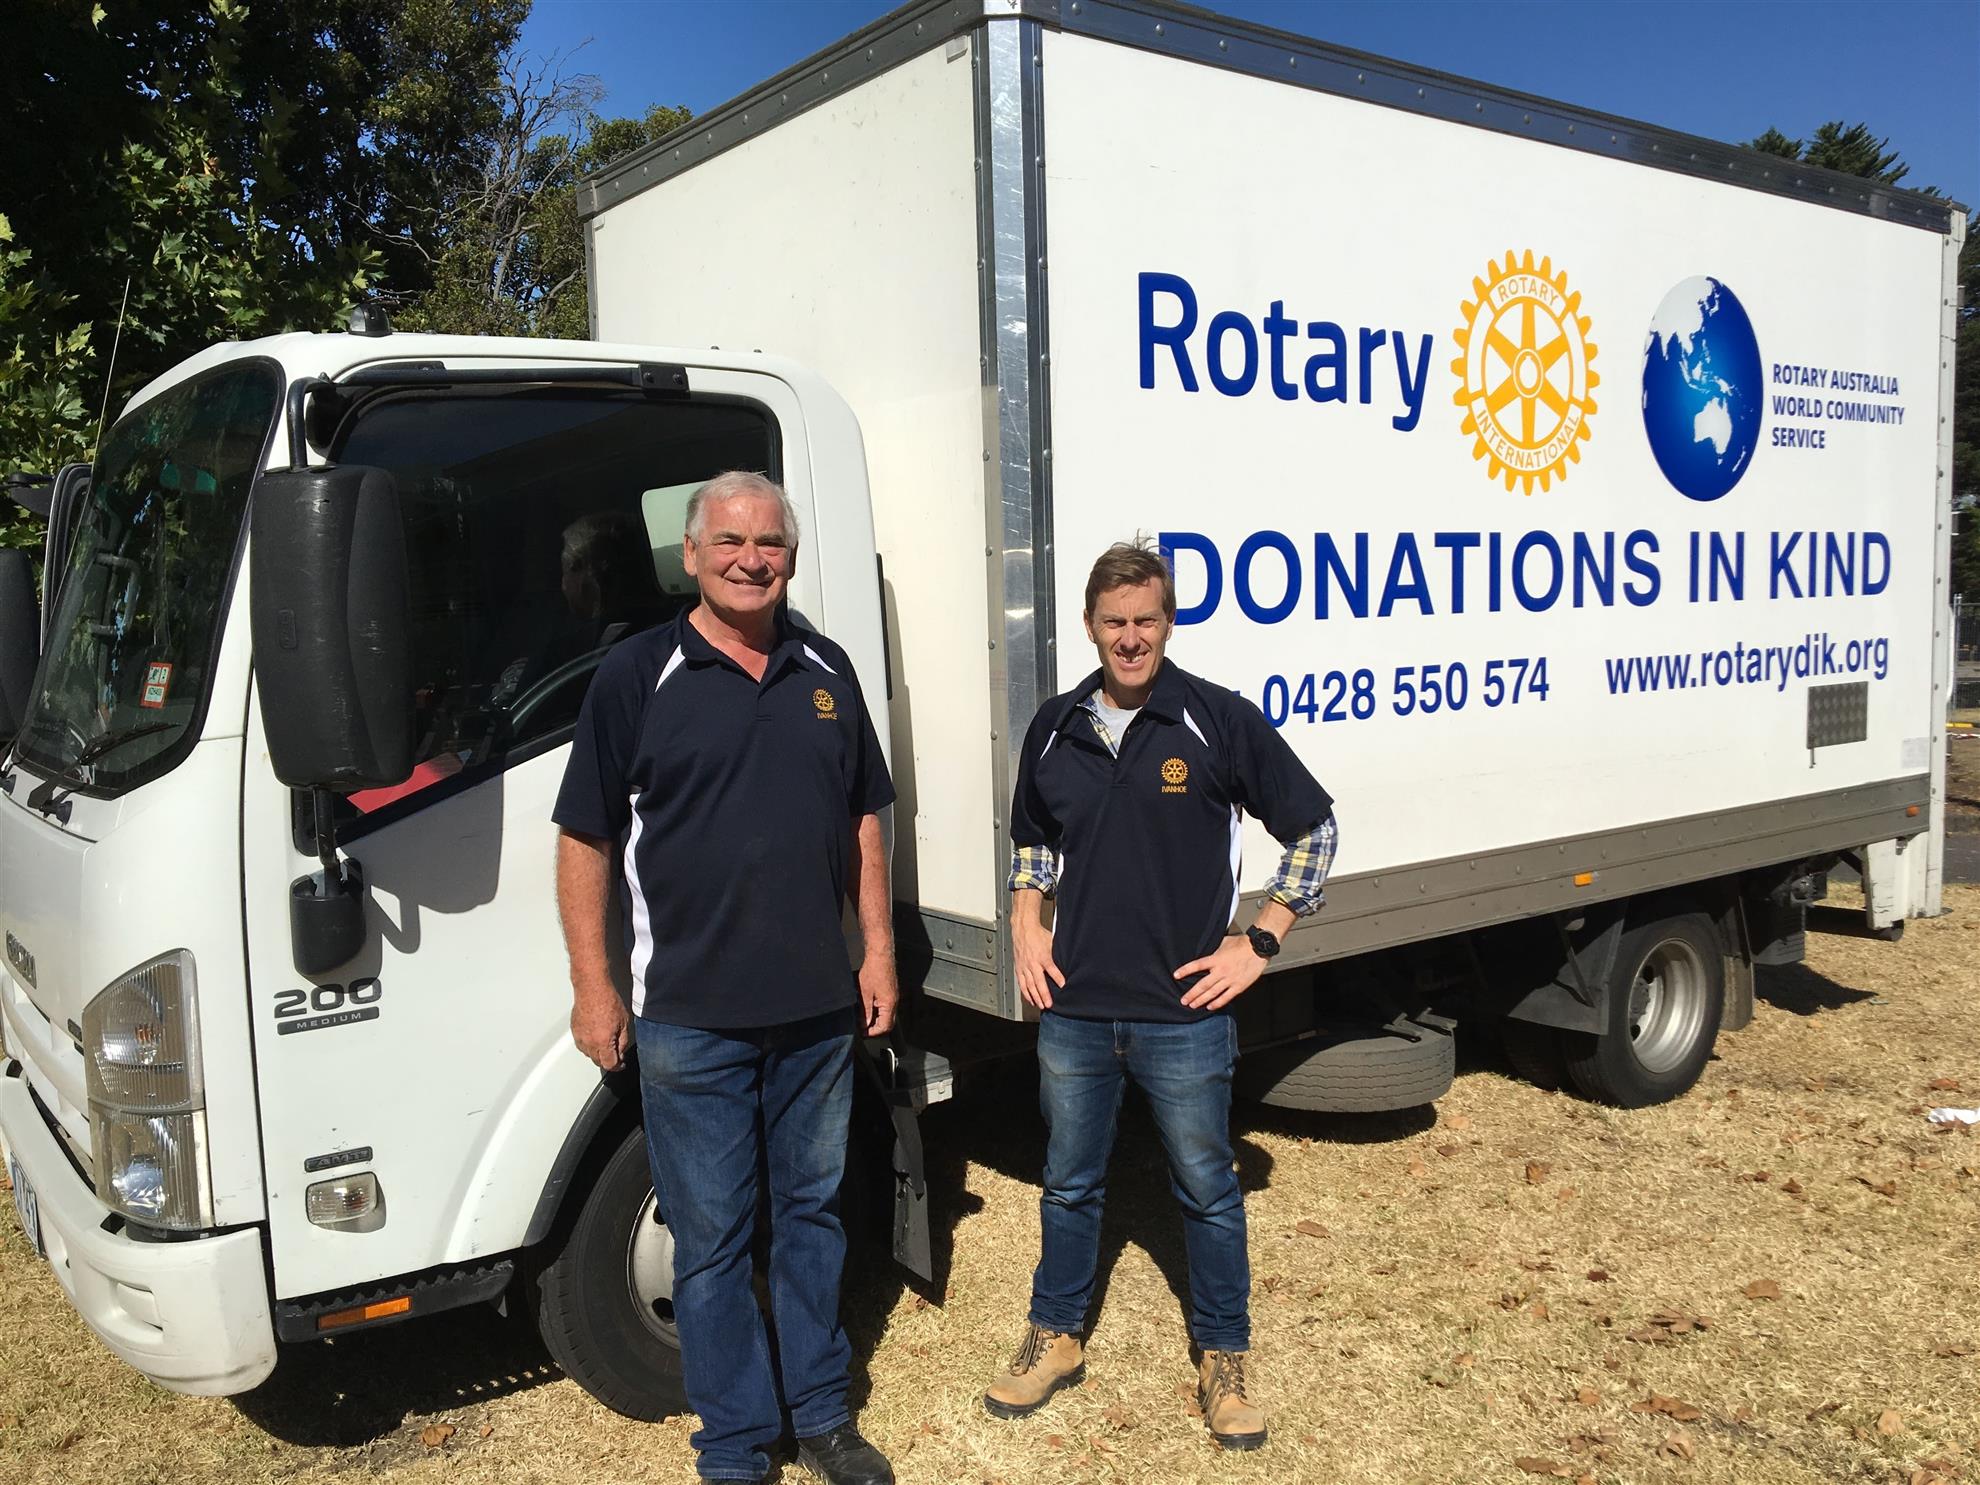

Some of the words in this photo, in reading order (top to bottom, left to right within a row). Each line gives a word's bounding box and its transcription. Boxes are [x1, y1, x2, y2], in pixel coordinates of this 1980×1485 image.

[1497, 277, 1558, 306] ROTARY
[1138, 271, 1434, 433] Rotary
[1773, 363, 1828, 388] ROTARY
[1830, 370, 1899, 395] AUSTRALIA
[1772, 395, 1823, 418] WORLD
[1826, 400, 1905, 425] COMMUNITY
[1476, 409, 1580, 469] INTERNATIONAL
[1772, 427, 1825, 449] SERVICE
[1158, 530, 1661, 626] DONATIONS
[1689, 531, 1745, 603] IN
[1769, 531, 1891, 600] KIND
[1605, 632, 1889, 695] www.rotarydik.org
[1262, 668, 1376, 729] 0428
[1392, 662, 1468, 717] 550
[1483, 656, 1550, 708] 574
[1161, 785, 1188, 793] IVANHOE
[273, 977, 382, 1019] 200
[296, 1012, 362, 1030] MEDIUM
